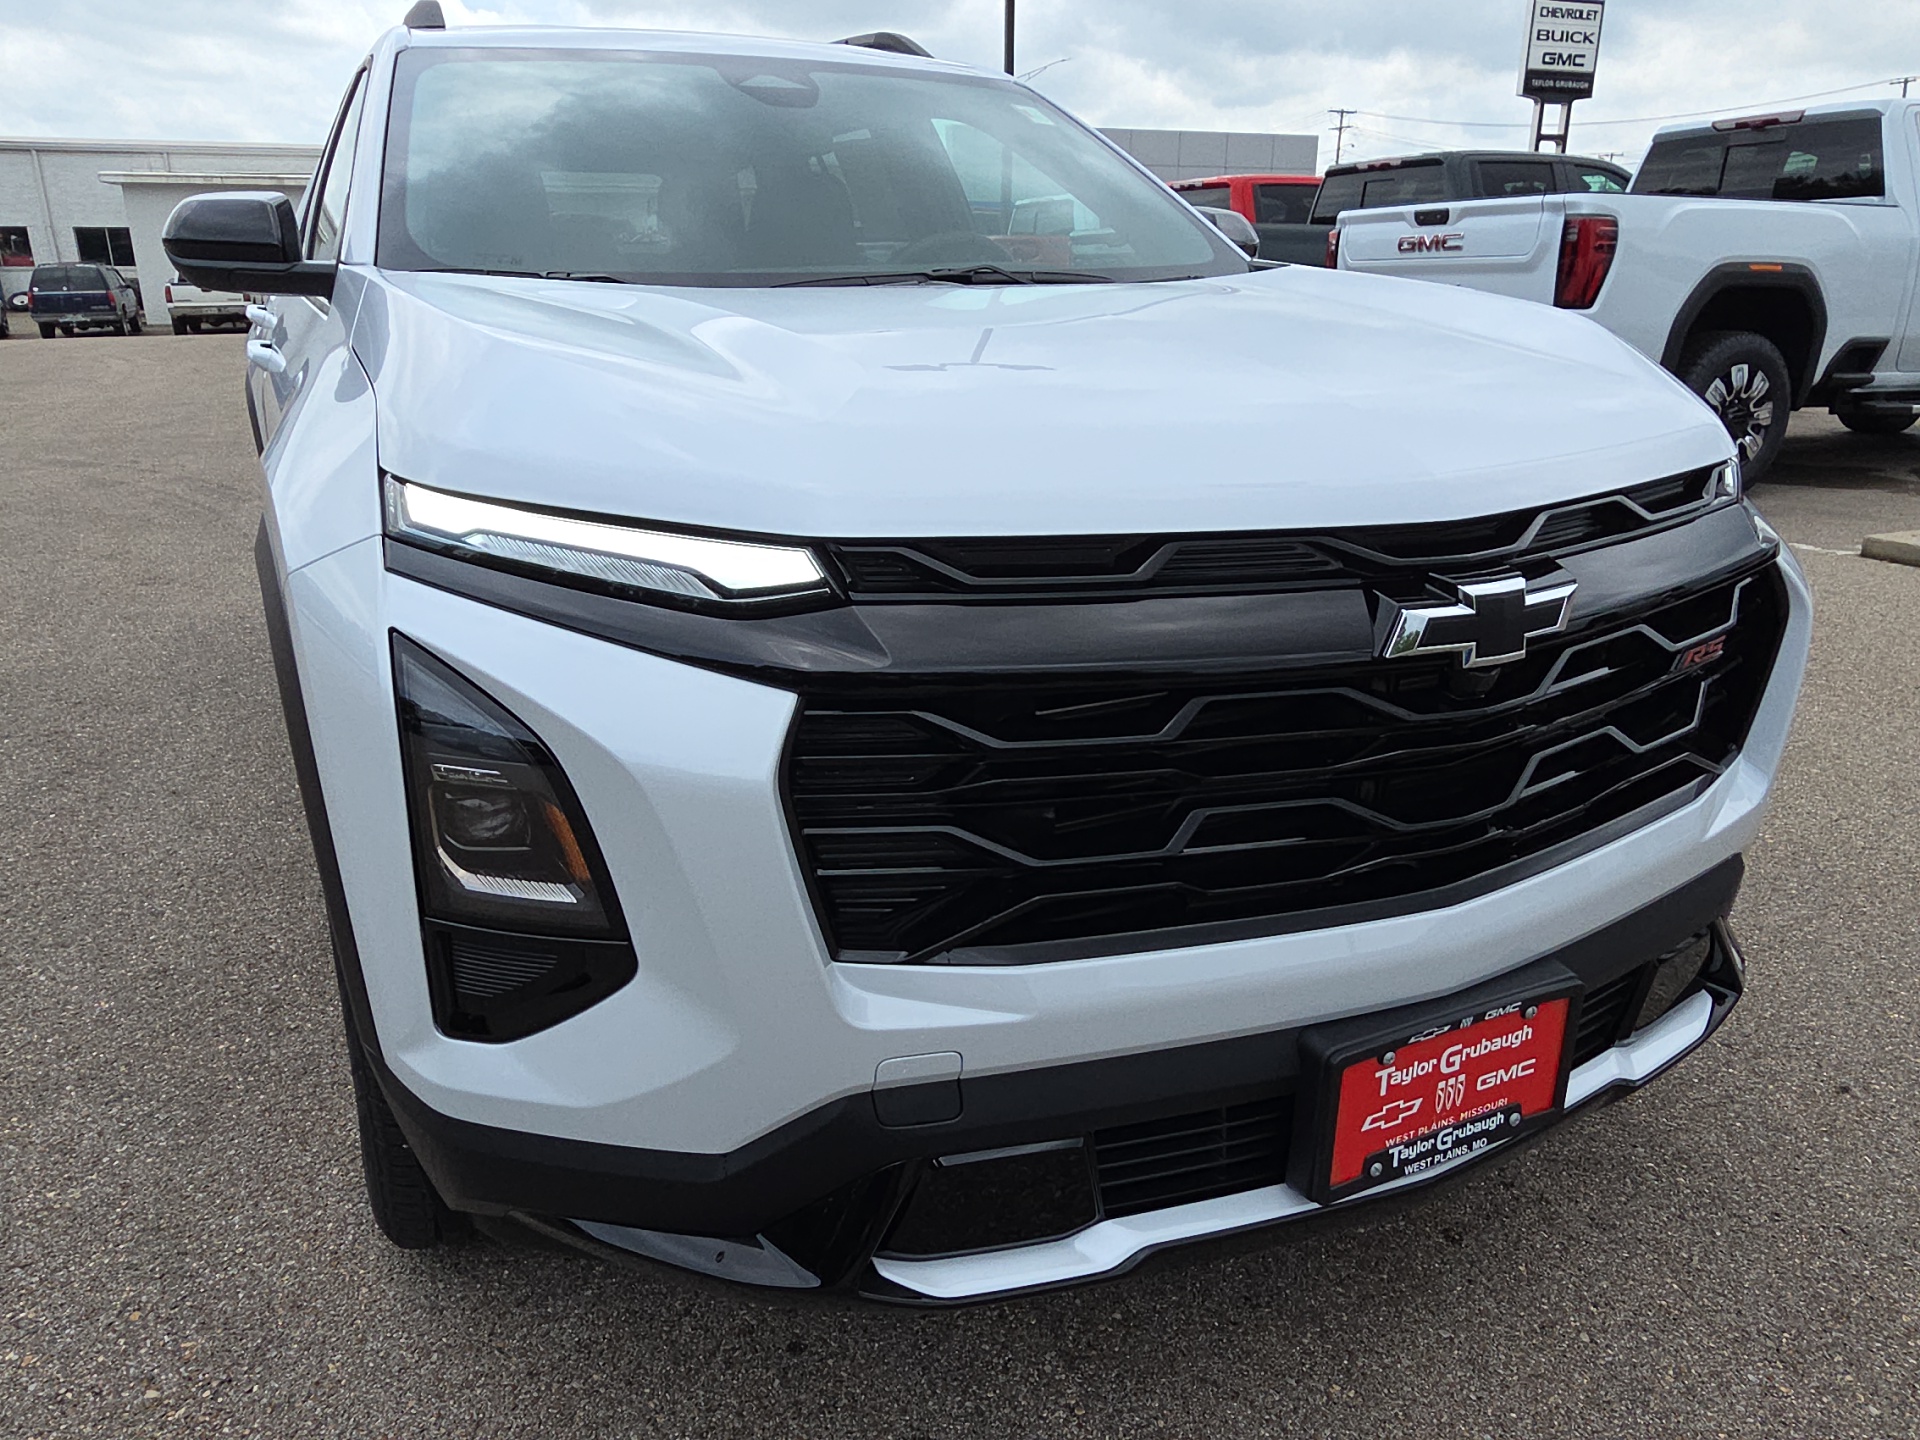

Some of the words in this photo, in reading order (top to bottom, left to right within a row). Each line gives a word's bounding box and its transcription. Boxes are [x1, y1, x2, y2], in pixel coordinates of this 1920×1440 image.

[1540, 6, 1599, 21] CHEVROLET
[1536, 29, 1595, 44] BUICK
[1541, 52, 1586, 67] GMC
[1532, 79, 1554, 87] TAYLOR
[1555, 80, 1589, 89] GRUBAUGH
[1398, 233, 1464, 253] GMC
[1681, 635, 1727, 669] RS
[1484, 1002, 1522, 1020] GMC
[1375, 1058, 1437, 1097] Taylor
[1440, 1025, 1533, 1074] Grubaugh
[1476, 1058, 1536, 1091] GMC
[1385, 1130, 1415, 1147] WEST
[1460, 1098, 1508, 1121] MISSOURI
[1389, 1138, 1435, 1168] Taylor
[1437, 1112, 1504, 1150] Grubaugh
[1404, 1158, 1432, 1175] WEST
[1434, 1145, 1470, 1165] PLAINS,
[1472, 1137, 1488, 1151] MO
